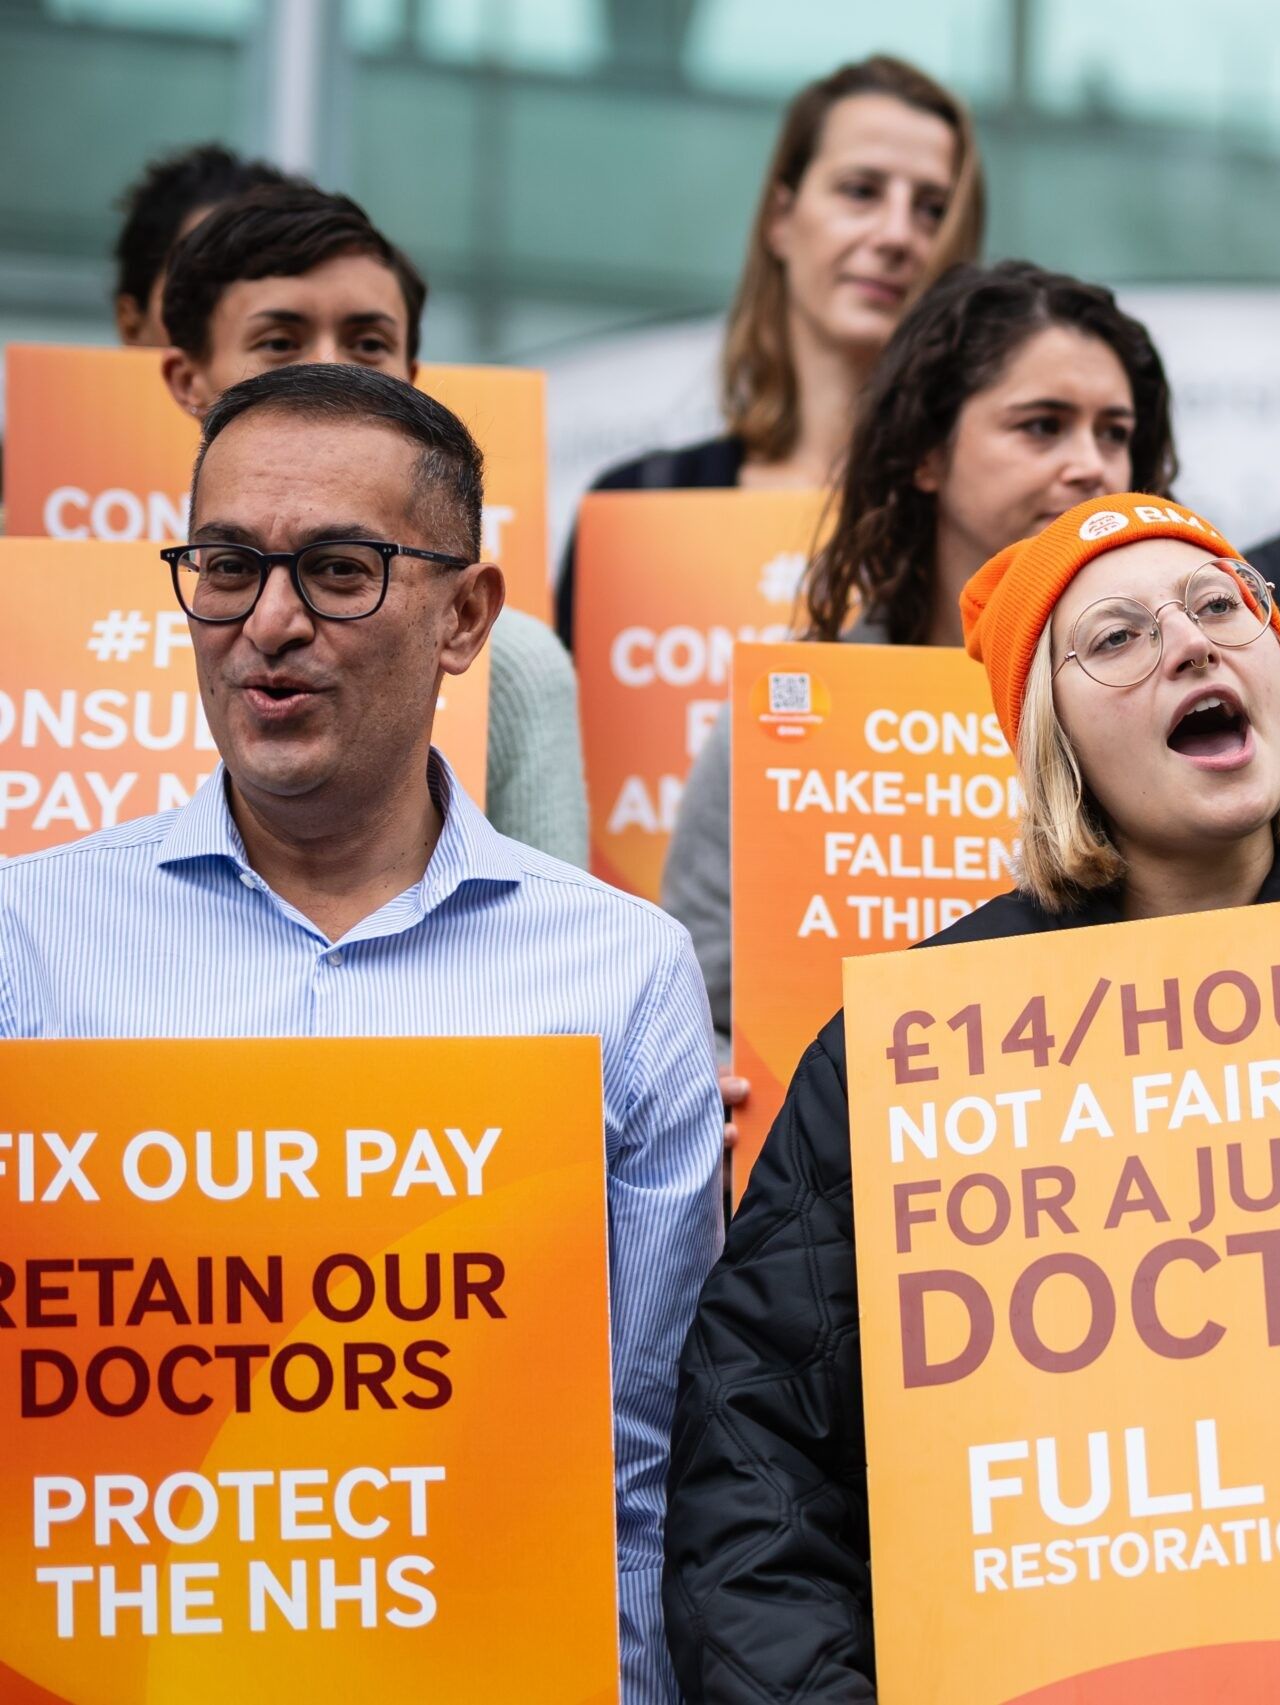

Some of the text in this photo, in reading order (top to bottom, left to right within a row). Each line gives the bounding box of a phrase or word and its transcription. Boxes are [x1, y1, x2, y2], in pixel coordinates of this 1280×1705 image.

[798, 895, 838, 939] A
[889, 1089, 1041, 1163] NOT
[1060, 1083, 1115, 1143] A
[122, 1130, 319, 1201] OUR
[346, 1128, 502, 1197] PAY
[893, 1165, 1078, 1254] FOR
[1105, 1155, 1171, 1229] A
[312, 1252, 507, 1322] OUR
[20, 1340, 453, 1418] DOCTORS
[34, 1466, 446, 1547] PROTECT
[968, 1418, 1265, 1536] FULL
[36, 1555, 437, 1638] THE NHS
